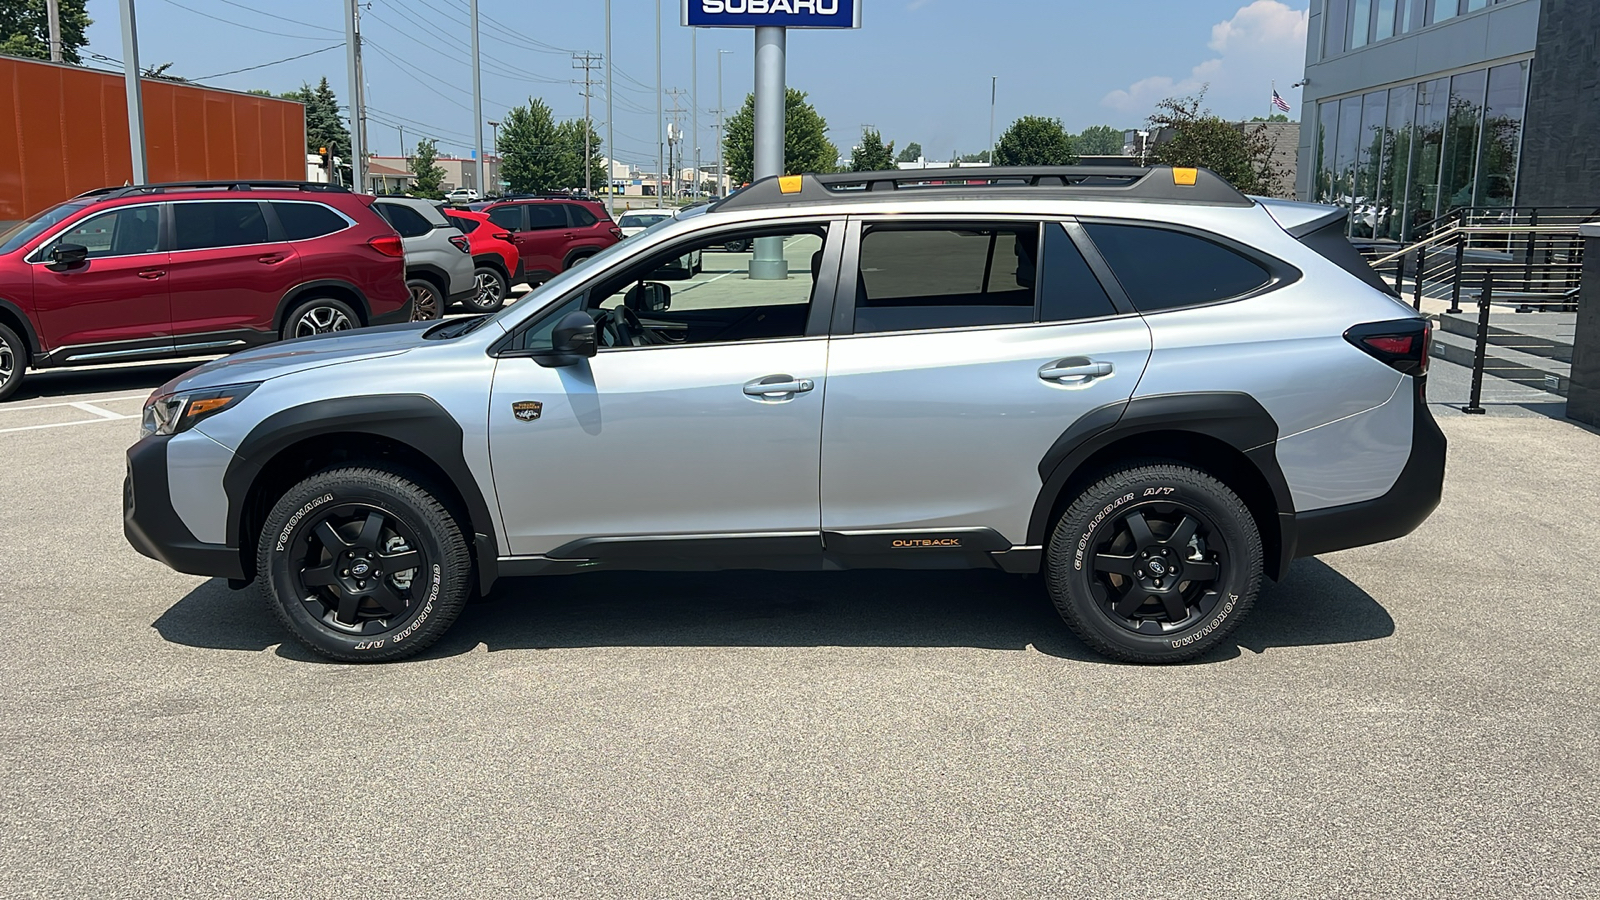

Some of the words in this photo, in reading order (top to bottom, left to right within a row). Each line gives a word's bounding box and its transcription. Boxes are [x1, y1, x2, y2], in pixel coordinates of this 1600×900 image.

[702, 0, 839, 15] SUBARU
[276, 493, 333, 552] YOKOHAMA
[892, 538, 960, 547] OUTBACK
[1074, 492, 1134, 570] GEOLANDAR
[1143, 487, 1175, 497] A/T
[393, 564, 441, 643] GEOLANDAR
[1171, 592, 1239, 648] YOKOHAMA
[354, 639, 385, 650] A/T
